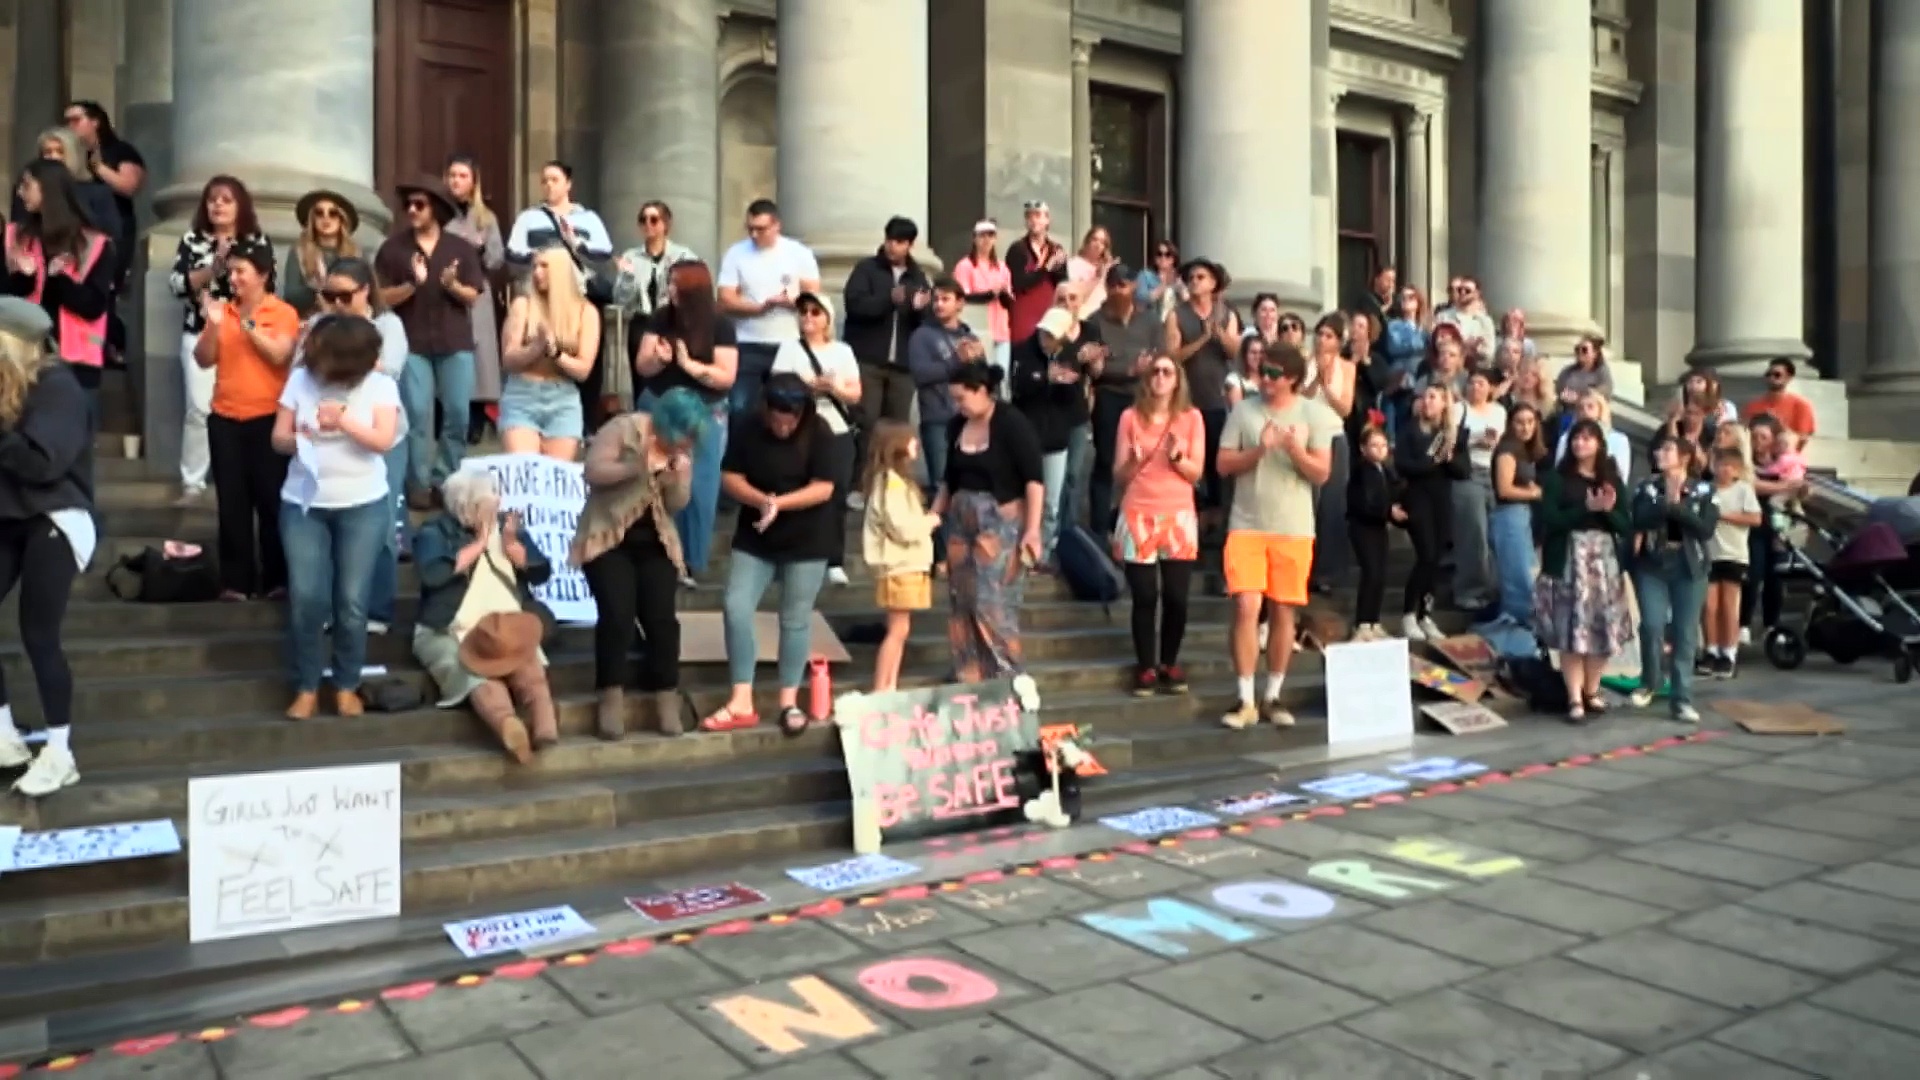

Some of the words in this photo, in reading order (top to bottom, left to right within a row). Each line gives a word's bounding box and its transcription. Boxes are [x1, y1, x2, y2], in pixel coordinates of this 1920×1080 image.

[514, 461, 541, 495] ARE
[550, 510, 579, 530] WIL
[951, 694, 1020, 734] Just
[203, 787, 272, 825] GIRLS
[332, 785, 394, 811] WANT
[929, 757, 1019, 814] SAFE
[217, 872, 306, 924] FEEL
[309, 865, 394, 907] SAFE
[711, 957, 999, 1054] NO
[1079, 836, 1526, 957] MORE
